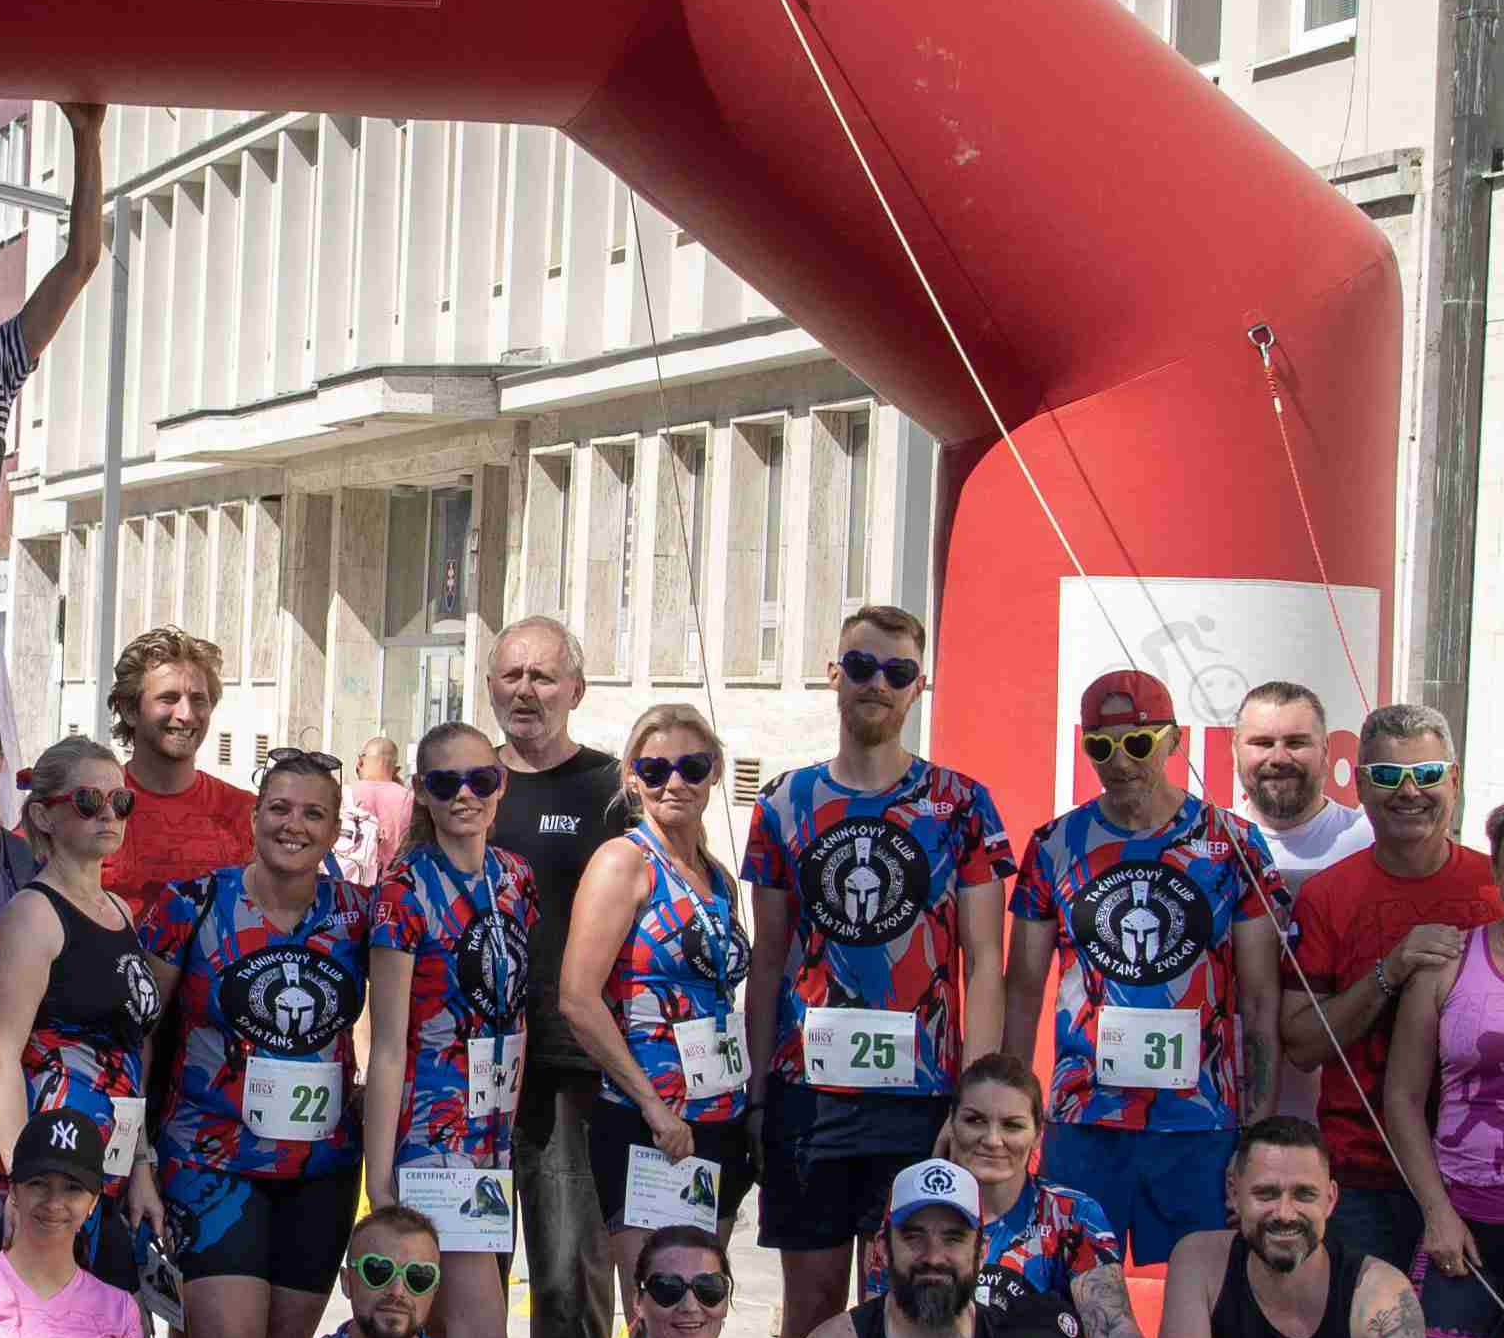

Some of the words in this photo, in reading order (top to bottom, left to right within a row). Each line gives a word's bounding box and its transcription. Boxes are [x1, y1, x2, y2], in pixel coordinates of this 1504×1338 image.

[918, 797, 955, 814] SWEEP
[811, 824, 887, 863] TRÉNINGOVÝ
[889, 834, 916, 862] KLUB
[1190, 839, 1230, 855] SWEEP
[1084, 867, 1163, 903] TRÉNINGOVÝ
[1166, 876, 1197, 904] KLUB
[325, 911, 361, 928] SWEEP
[812, 901, 862, 940] SPARTANS
[872, 898, 916, 935] ZVOLEN
[235, 950, 310, 981] TRÉNINGOVÝ
[1087, 940, 1142, 980] SPARTANS
[1154, 938, 1198, 974] ZVOLEN
[849, 1031, 896, 1070] 25
[1143, 1032, 1184, 1070] 31
[289, 1084, 331, 1123] 22
